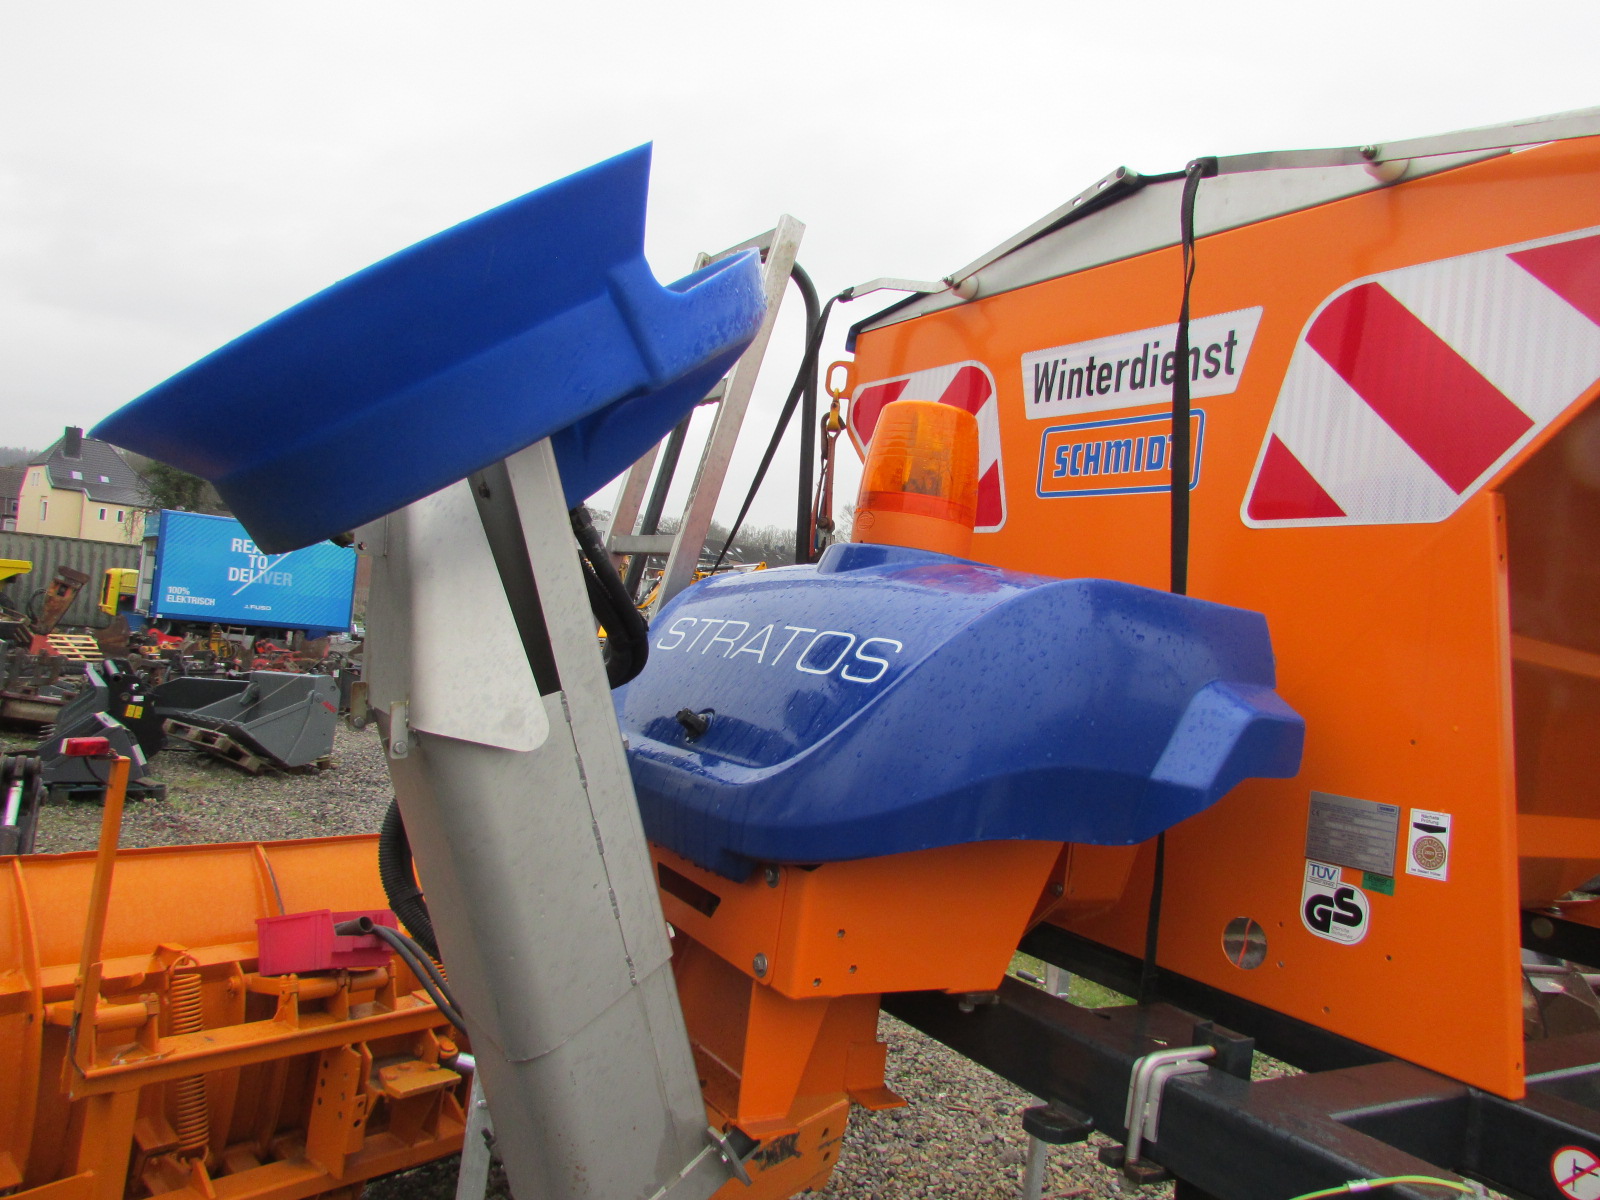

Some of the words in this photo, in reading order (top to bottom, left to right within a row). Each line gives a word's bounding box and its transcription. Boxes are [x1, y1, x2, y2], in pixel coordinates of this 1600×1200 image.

[1033, 330, 1238, 405] Winterdienst
[231, 537, 282, 556] REA
[248, 554, 268, 570] TO
[228, 566, 293, 587] DELIVER
[167, 586, 190, 595] 100%
[166, 595, 216, 606] ELEKTRISCH
[656, 617, 903, 684] STRATOS
[1309, 863, 1337, 880] TÜV
[1304, 886, 1363, 933] GS
